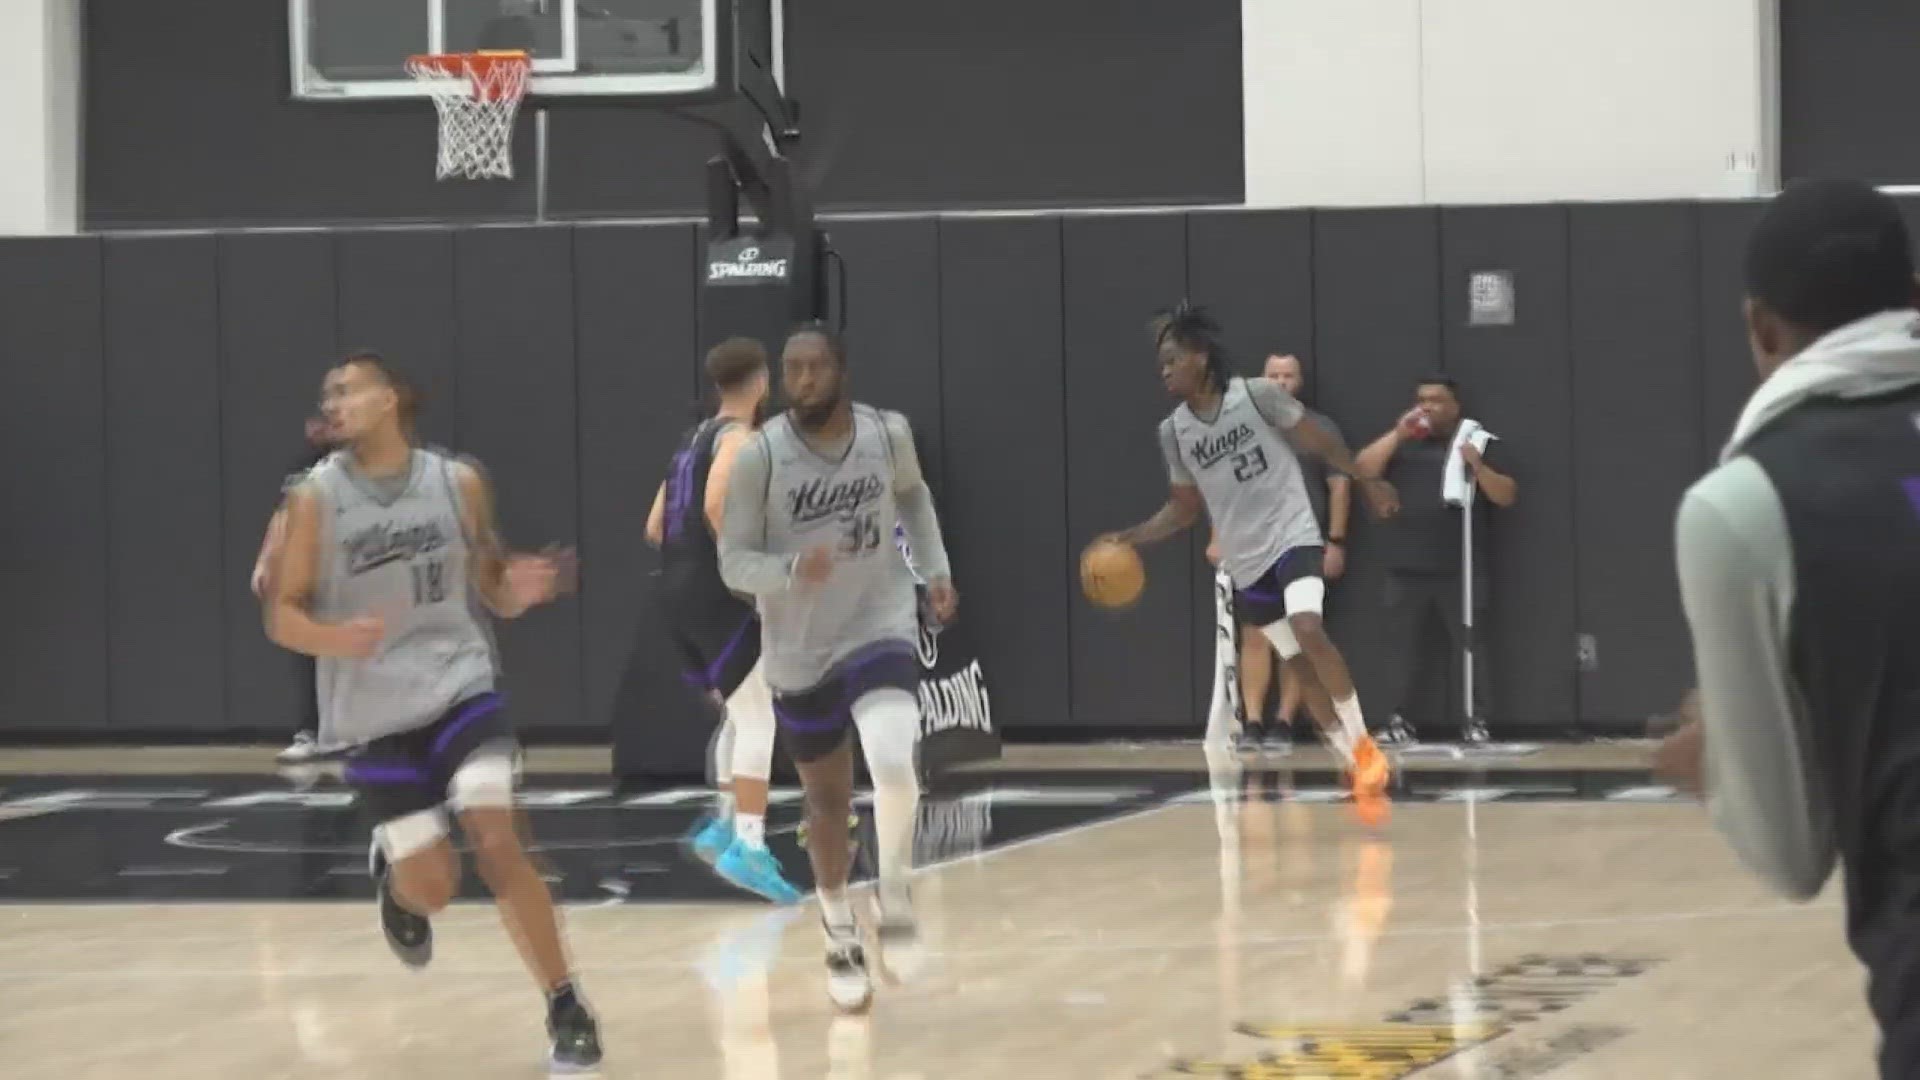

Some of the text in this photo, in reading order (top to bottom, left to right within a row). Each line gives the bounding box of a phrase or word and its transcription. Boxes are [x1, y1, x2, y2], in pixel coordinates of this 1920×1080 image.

[708, 259, 787, 280] SPALDING
[1191, 423, 1256, 469] Kings
[1231, 444, 1268, 483] 23
[788, 473, 885, 523] Kings
[918, 659, 992, 735] PALDING
